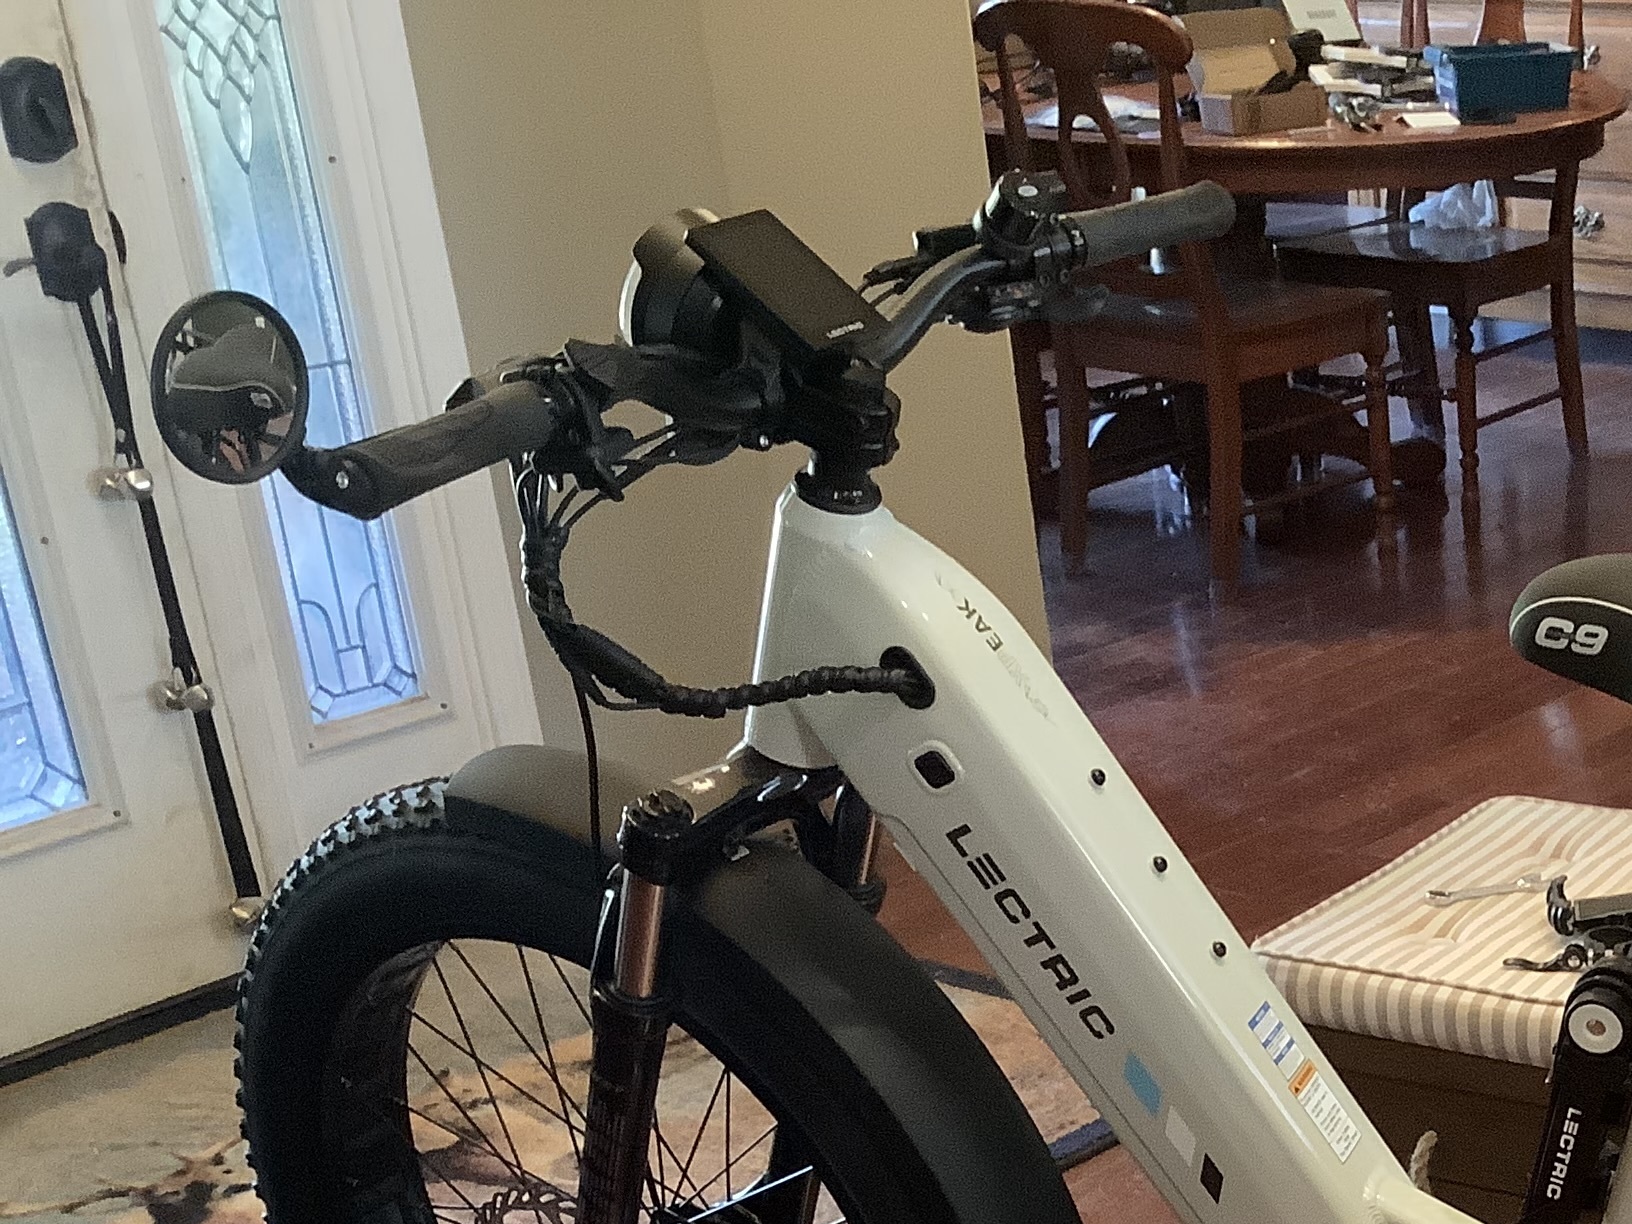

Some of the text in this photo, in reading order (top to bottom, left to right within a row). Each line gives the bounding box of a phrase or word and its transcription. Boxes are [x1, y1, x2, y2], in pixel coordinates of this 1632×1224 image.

[1535, 616, 1609, 656] C9
[946, 823, 1116, 1040] LECTRIC
[1545, 1106, 1583, 1200] LECTRIC
